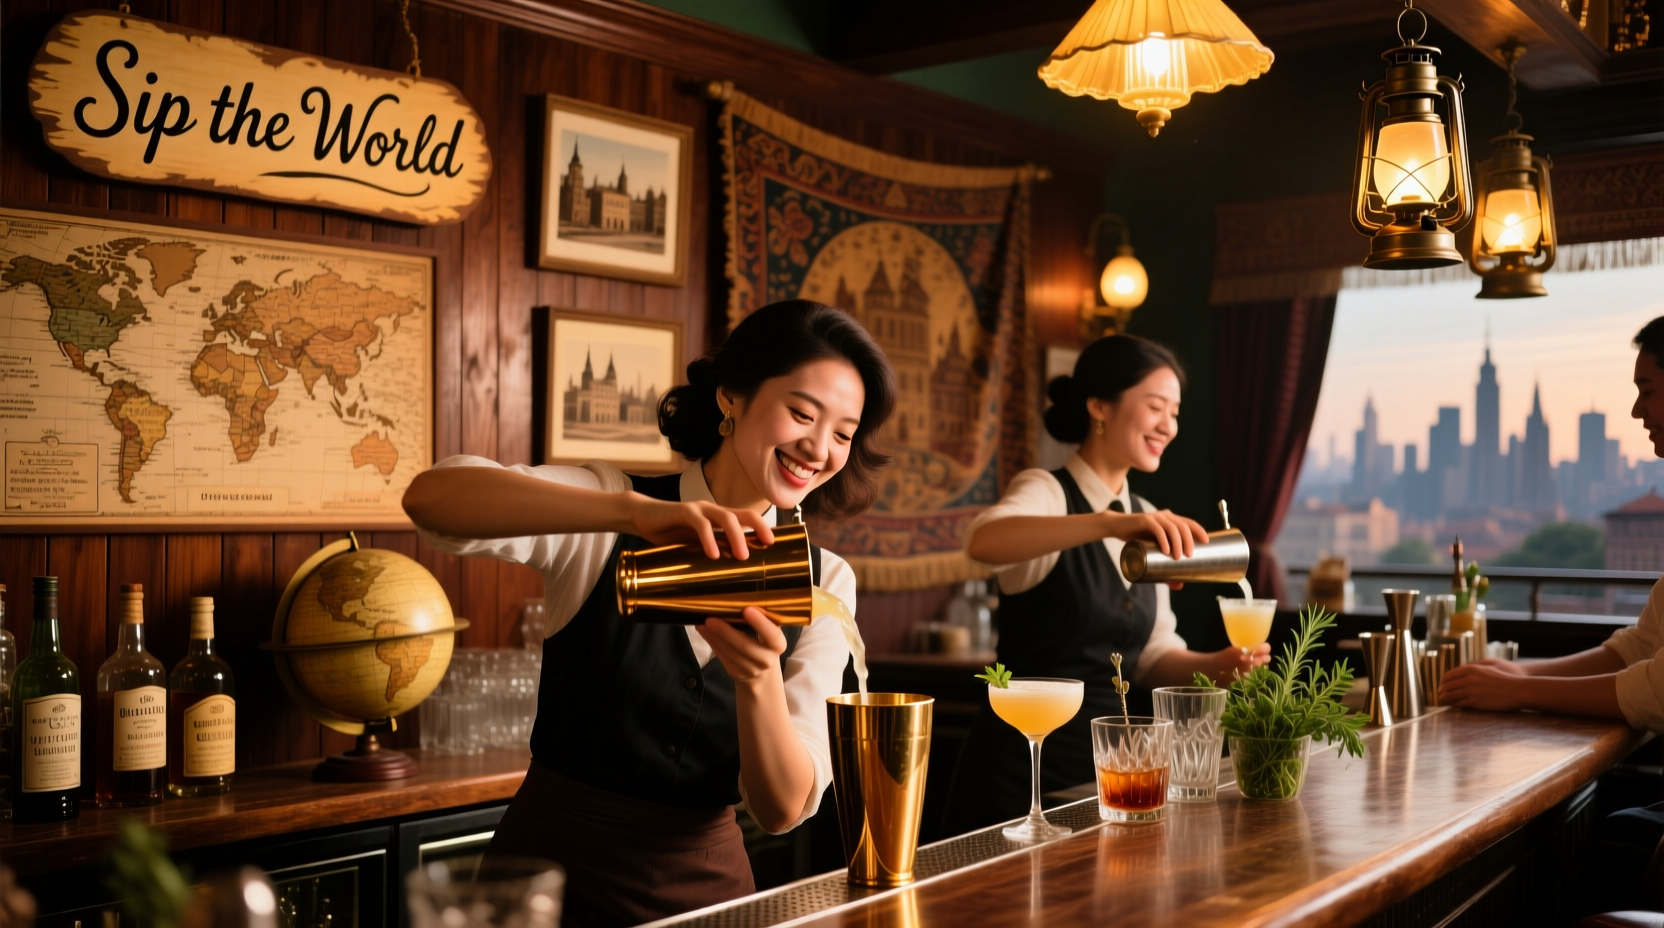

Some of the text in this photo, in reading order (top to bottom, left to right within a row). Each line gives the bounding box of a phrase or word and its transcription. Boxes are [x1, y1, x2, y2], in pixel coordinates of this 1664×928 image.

[73, 38, 465, 178] Sip the World
